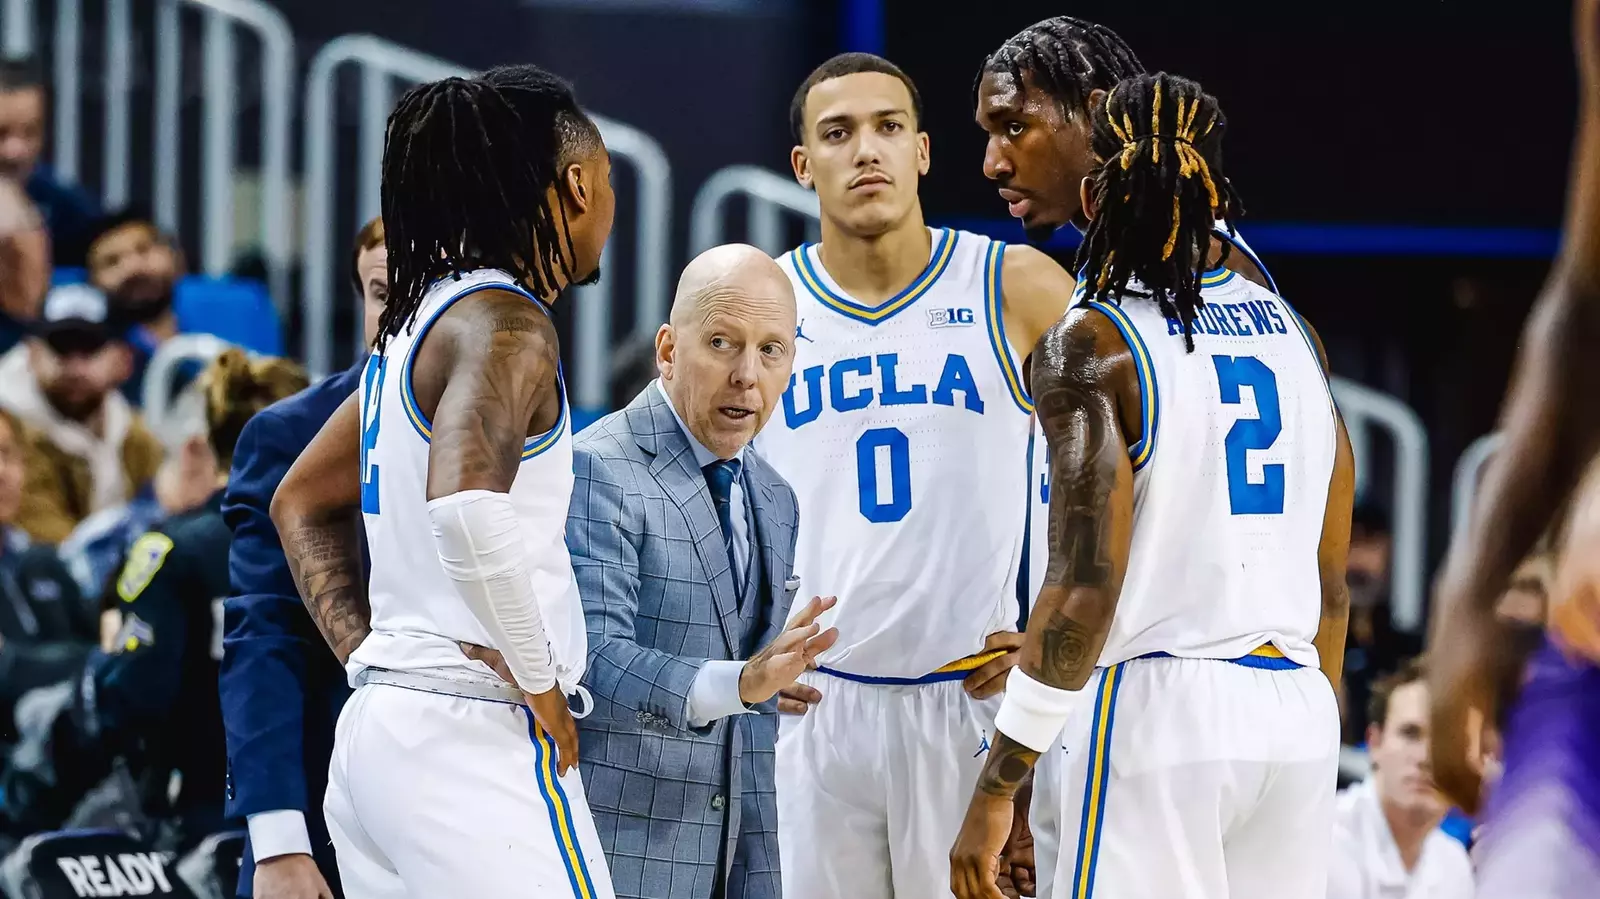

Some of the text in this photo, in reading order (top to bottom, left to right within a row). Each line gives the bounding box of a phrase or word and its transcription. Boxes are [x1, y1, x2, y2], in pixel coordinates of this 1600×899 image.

[782, 353, 985, 429] UCLA
[856, 427, 912, 523] 0
[1211, 354, 1285, 516] 2
[56, 852, 175, 898] READY
